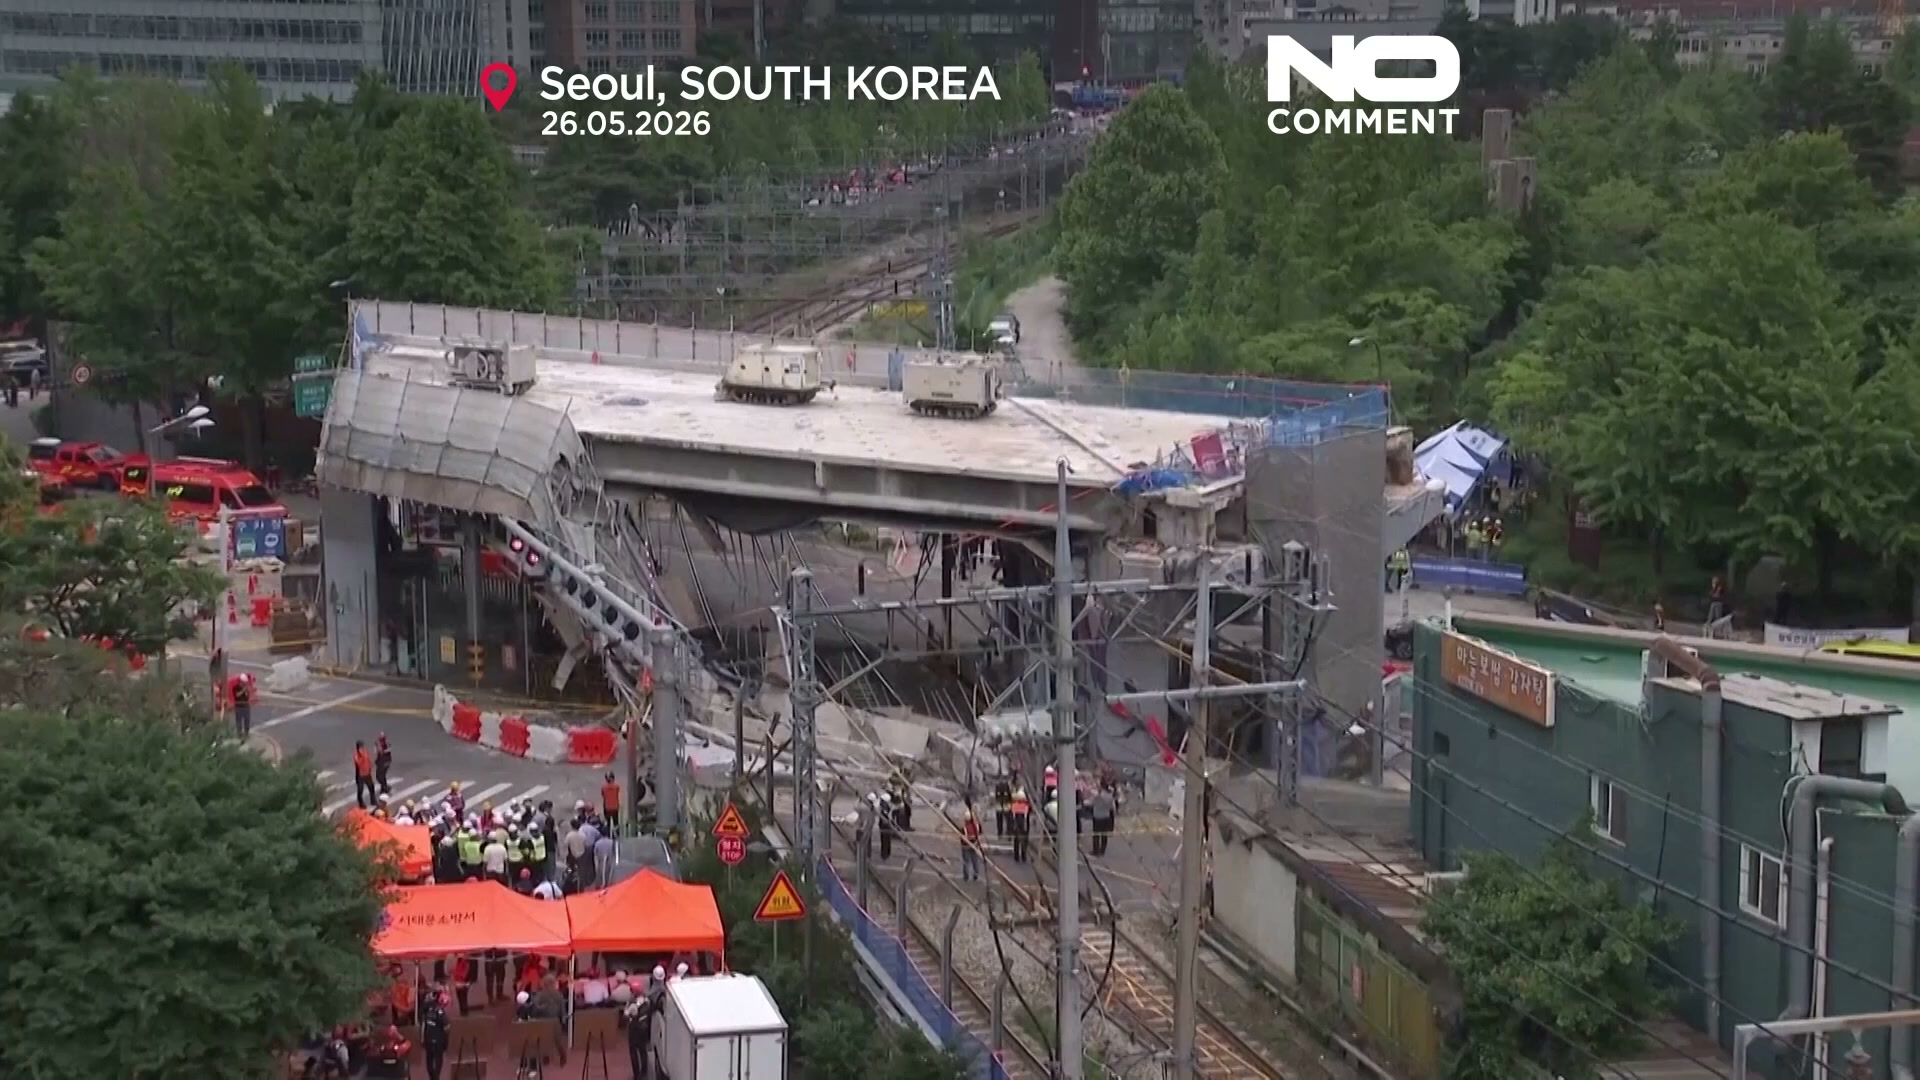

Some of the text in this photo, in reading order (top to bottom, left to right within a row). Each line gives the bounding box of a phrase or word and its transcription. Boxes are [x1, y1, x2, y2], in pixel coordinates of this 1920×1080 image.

[1508, 666, 1544, 706] 감자탕
[722, 851, 741, 860] STOP
[399, 911, 475, 927] 서대문소방서
